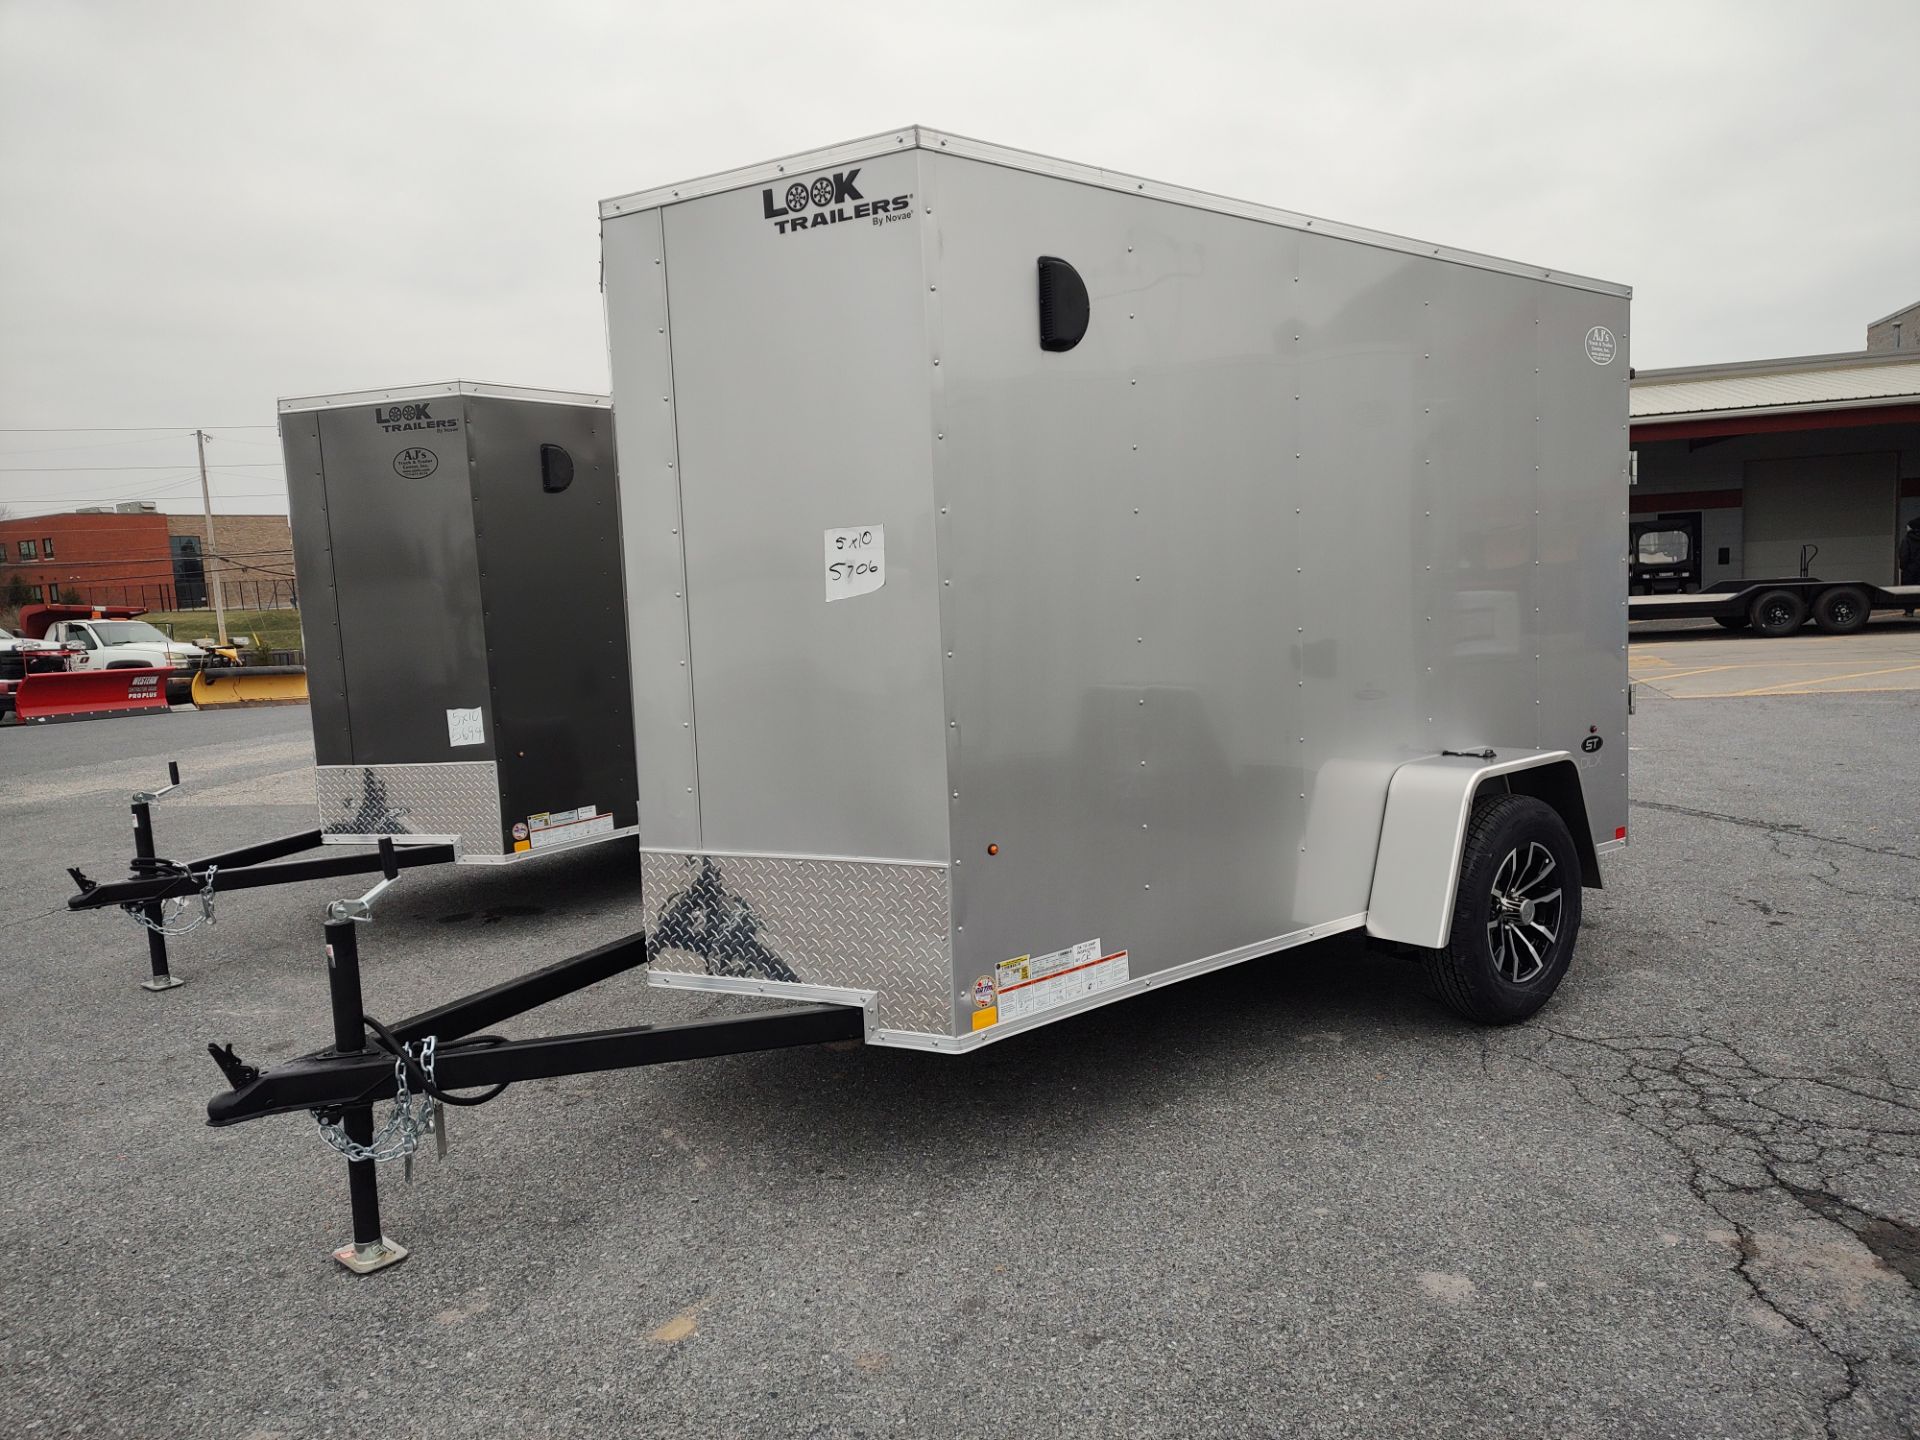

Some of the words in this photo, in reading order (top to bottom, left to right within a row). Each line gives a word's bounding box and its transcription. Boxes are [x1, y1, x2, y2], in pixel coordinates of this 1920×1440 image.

[763, 168, 864, 219] LOOK
[774, 195, 909, 234] TRAILERS
[873, 217, 884, 227] By
[885, 211, 911, 223] Novae
[1593, 329, 1609, 342] AJ's
[375, 403, 432, 424] LOOK
[382, 419, 458, 433] TRAILERS
[404, 450, 427, 461] AJ's
[829, 560, 879, 581] 5706
[1585, 738, 1599, 751] ST
[1580, 755, 1602, 769] DLX
